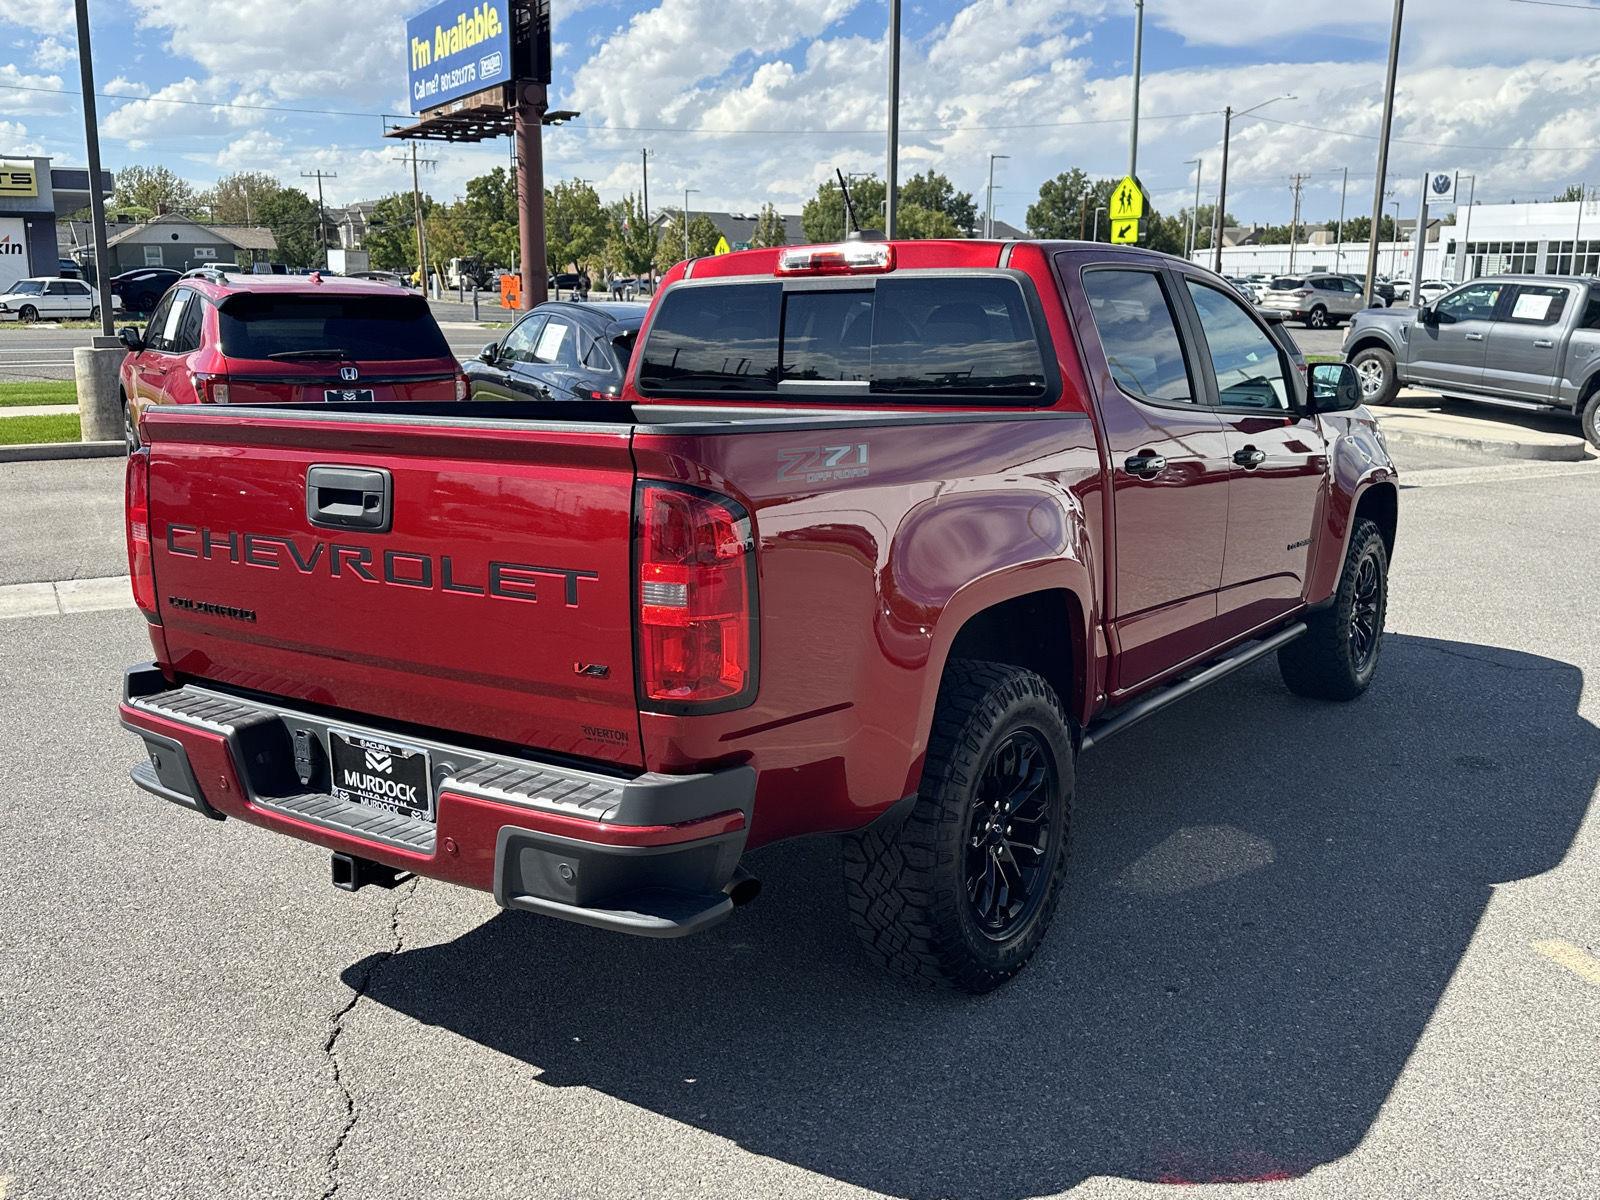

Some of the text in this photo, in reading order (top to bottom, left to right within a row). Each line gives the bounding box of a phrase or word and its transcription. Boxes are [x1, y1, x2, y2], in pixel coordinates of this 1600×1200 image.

[412, 2, 502, 71] I'm Available.
[414, 79, 426, 100] Call
[426, 74, 439, 95] me?
[777, 442, 870, 483] Z71
[167, 523, 599, 609] CHEVROLET
[366, 741, 391, 753] ACURA
[344, 769, 418, 803] MURDOCK
[360, 796, 399, 814] MURDOCK
